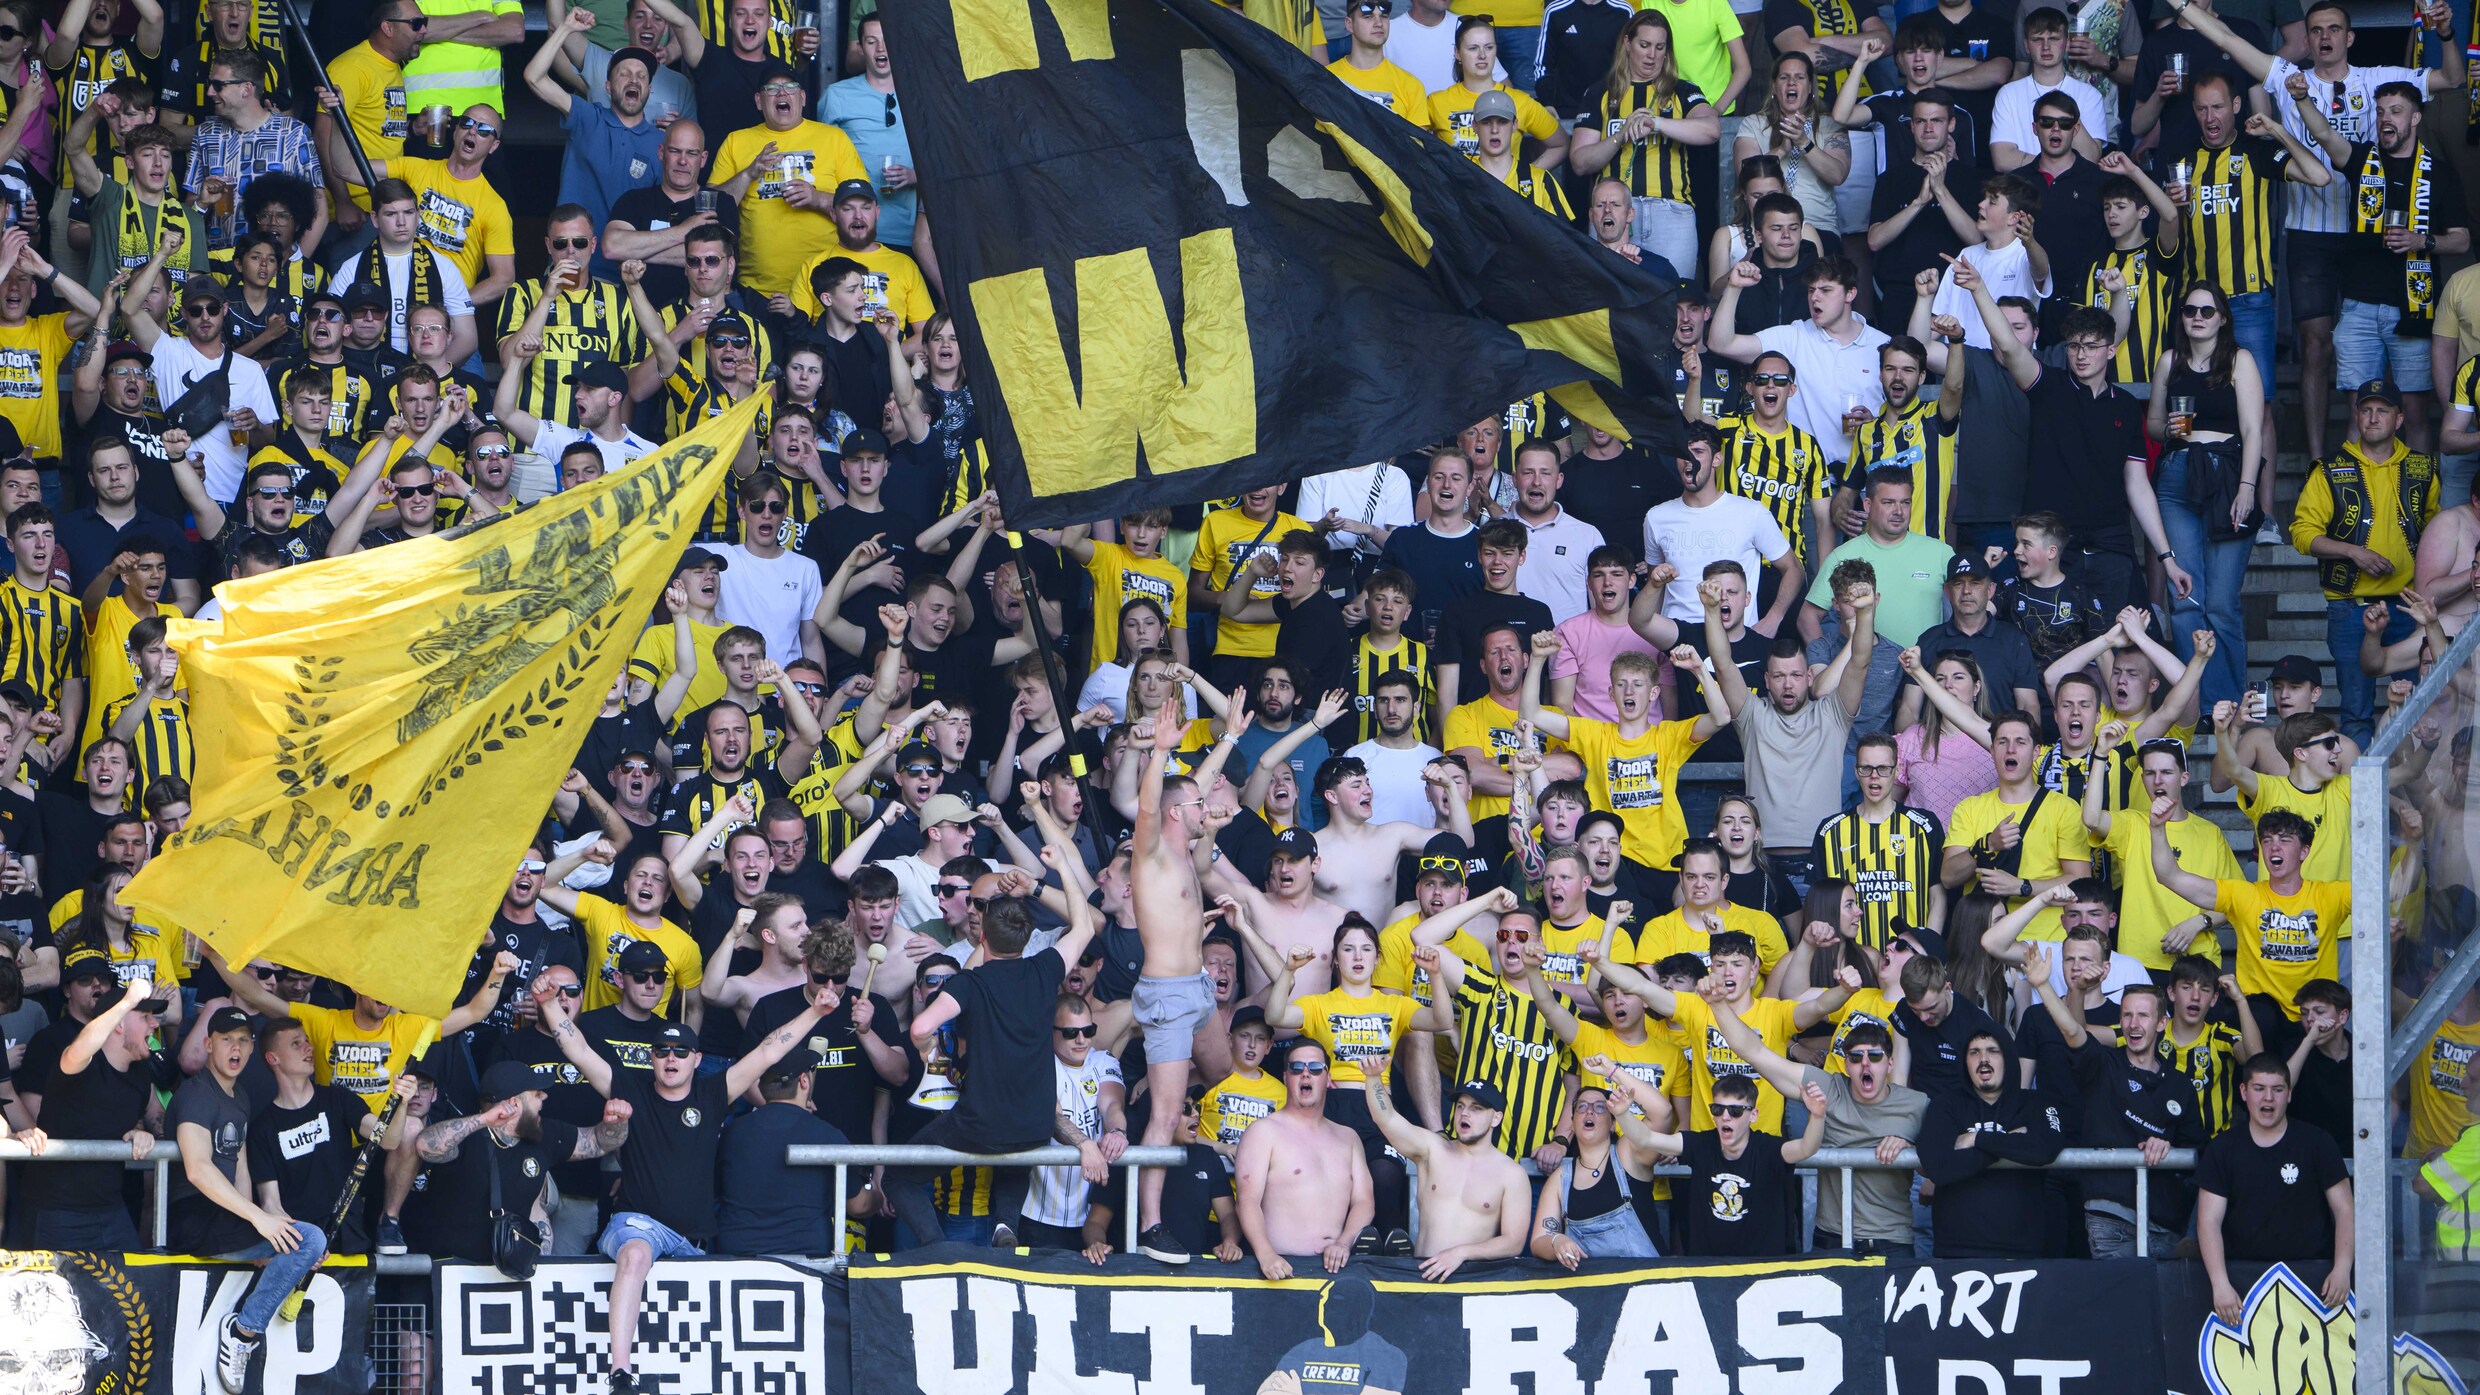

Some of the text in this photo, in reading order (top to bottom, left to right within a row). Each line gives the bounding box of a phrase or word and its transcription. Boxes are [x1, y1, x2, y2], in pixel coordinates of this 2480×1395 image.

[2201, 183, 2233, 199] BET
[430, 194, 464, 220] VOOR
[2202, 198, 2240, 215] CITY
[421, 209, 458, 234] GEEL
[2344, 503, 2359, 527] 026
[1666, 530, 1736, 551] HUGO
[1131, 575, 1167, 595] VOOR
[1613, 791, 1653, 802] ZWART
[1857, 871, 1896, 881] WATER
[1863, 892, 1892, 902] .COM
[2270, 912, 2309, 930] VOOR
[2267, 929, 2310, 944] GEEL
[2267, 945, 2309, 955] ZWART
[1340, 1017, 1383, 1029] VOOR
[1340, 1030, 1383, 1044] GEEL
[338, 1046, 381, 1061] VOOR
[1340, 1046, 1382, 1055] ZWART
[337, 1062, 380, 1076] GEEL
[1711, 1062, 1752, 1074] ZWART
[337, 1078, 379, 1088] ZWART
[1228, 1098, 1268, 1116] VOOR
[2125, 1109, 2144, 1125] BLACK
[1885, 1266, 2038, 1338] ART
[901, 1274, 1844, 1395] ULT RAS
[1301, 1364, 1361, 1385] CREW.81
